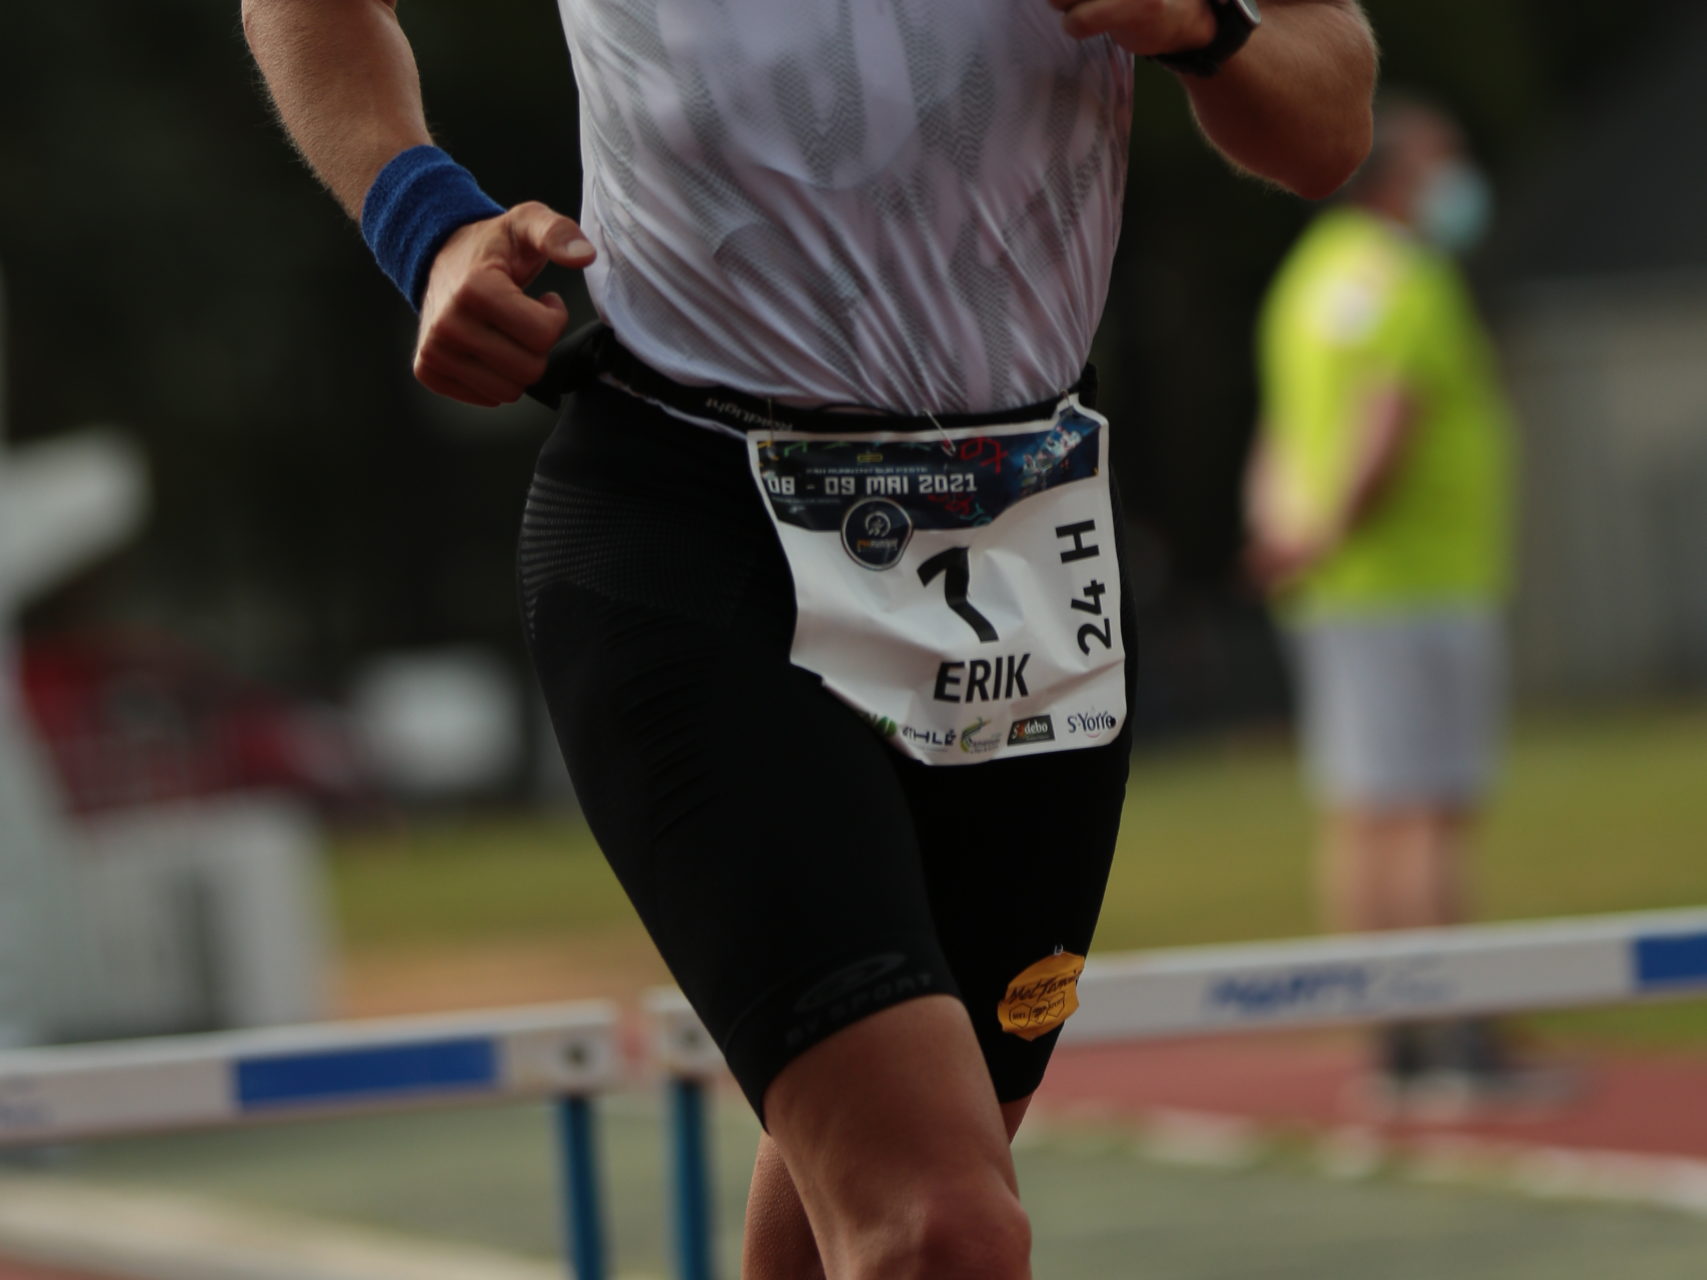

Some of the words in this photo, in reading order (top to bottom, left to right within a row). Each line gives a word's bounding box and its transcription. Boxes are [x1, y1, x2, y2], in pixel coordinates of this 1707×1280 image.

[824, 476, 856, 495] 09
[866, 475, 909, 495] MAI
[918, 473, 978, 494] 2021
[1055, 518, 1101, 564] H
[1070, 579, 1113, 656] 24
[933, 653, 1031, 704] ERIK
